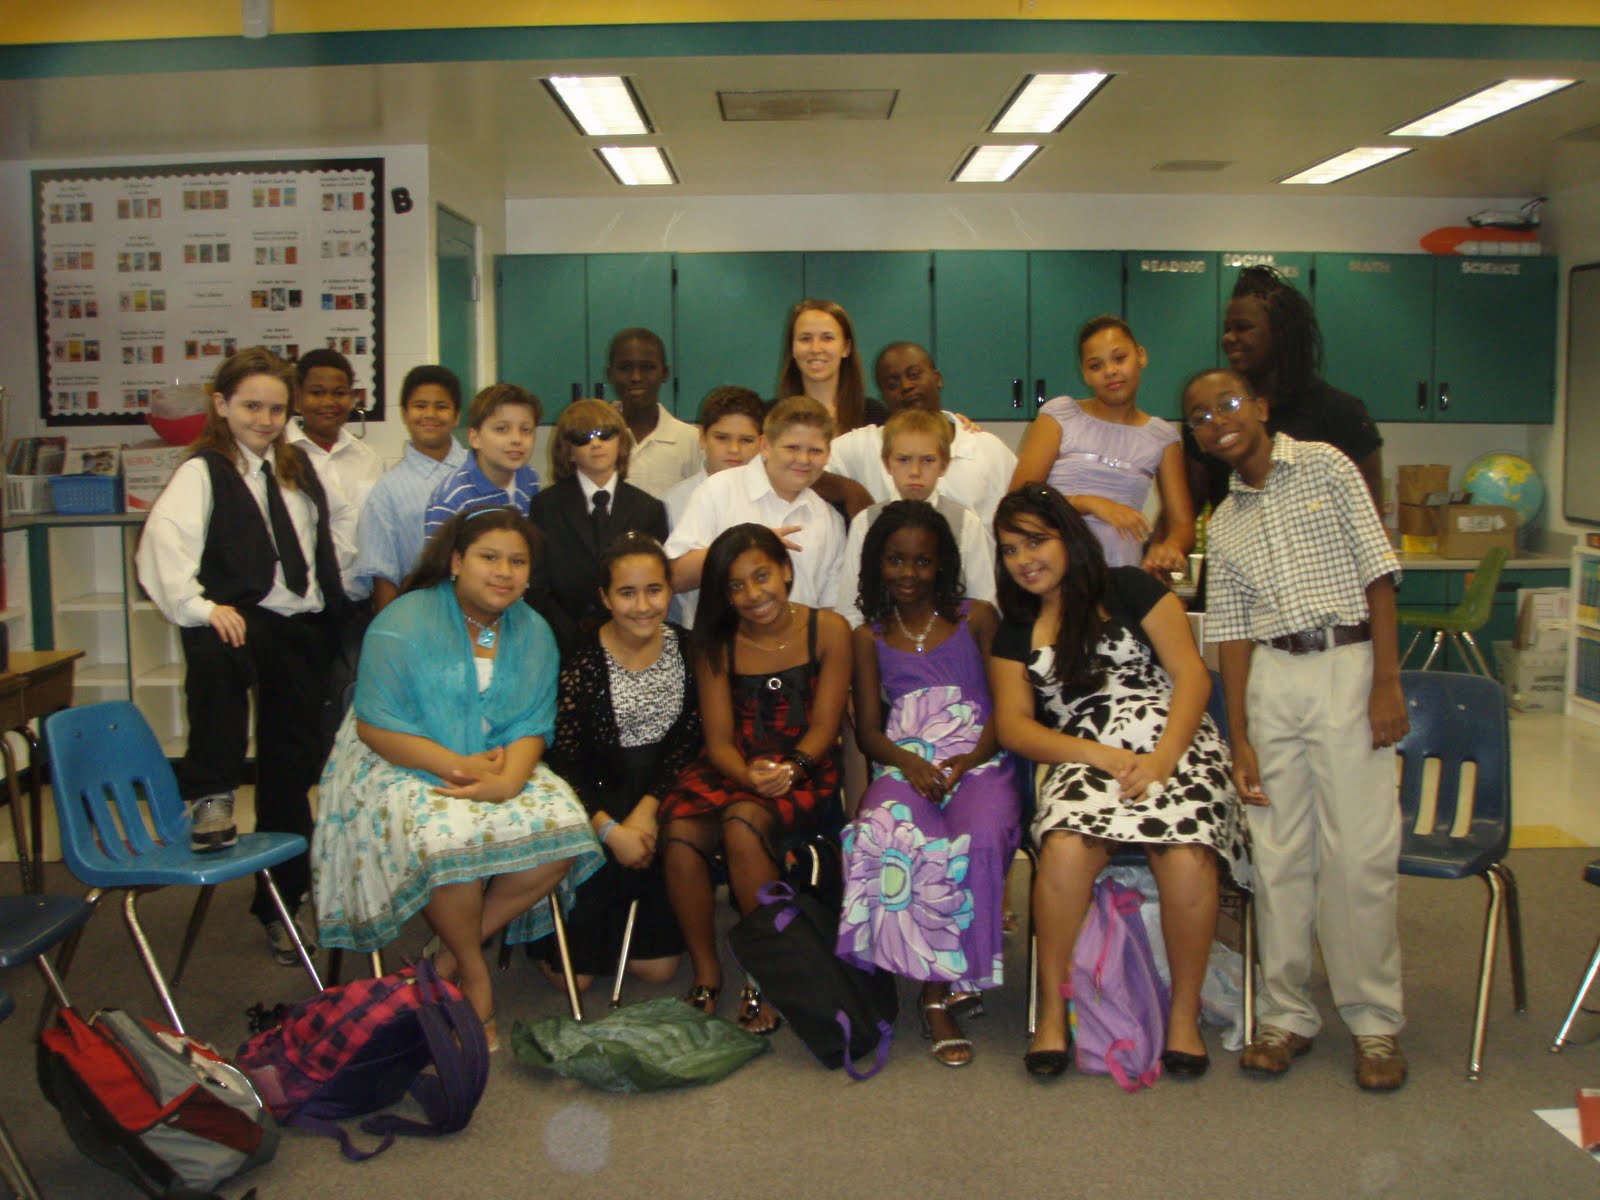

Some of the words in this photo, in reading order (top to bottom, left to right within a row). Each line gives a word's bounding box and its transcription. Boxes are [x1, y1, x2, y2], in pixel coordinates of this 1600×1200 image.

[391, 187, 414, 214] B
[1141, 259, 1206, 273] READING
[1223, 253, 1275, 267] SOCIAL
[1348, 260, 1392, 273] MATH
[1461, 261, 1520, 275] SCIENCE
